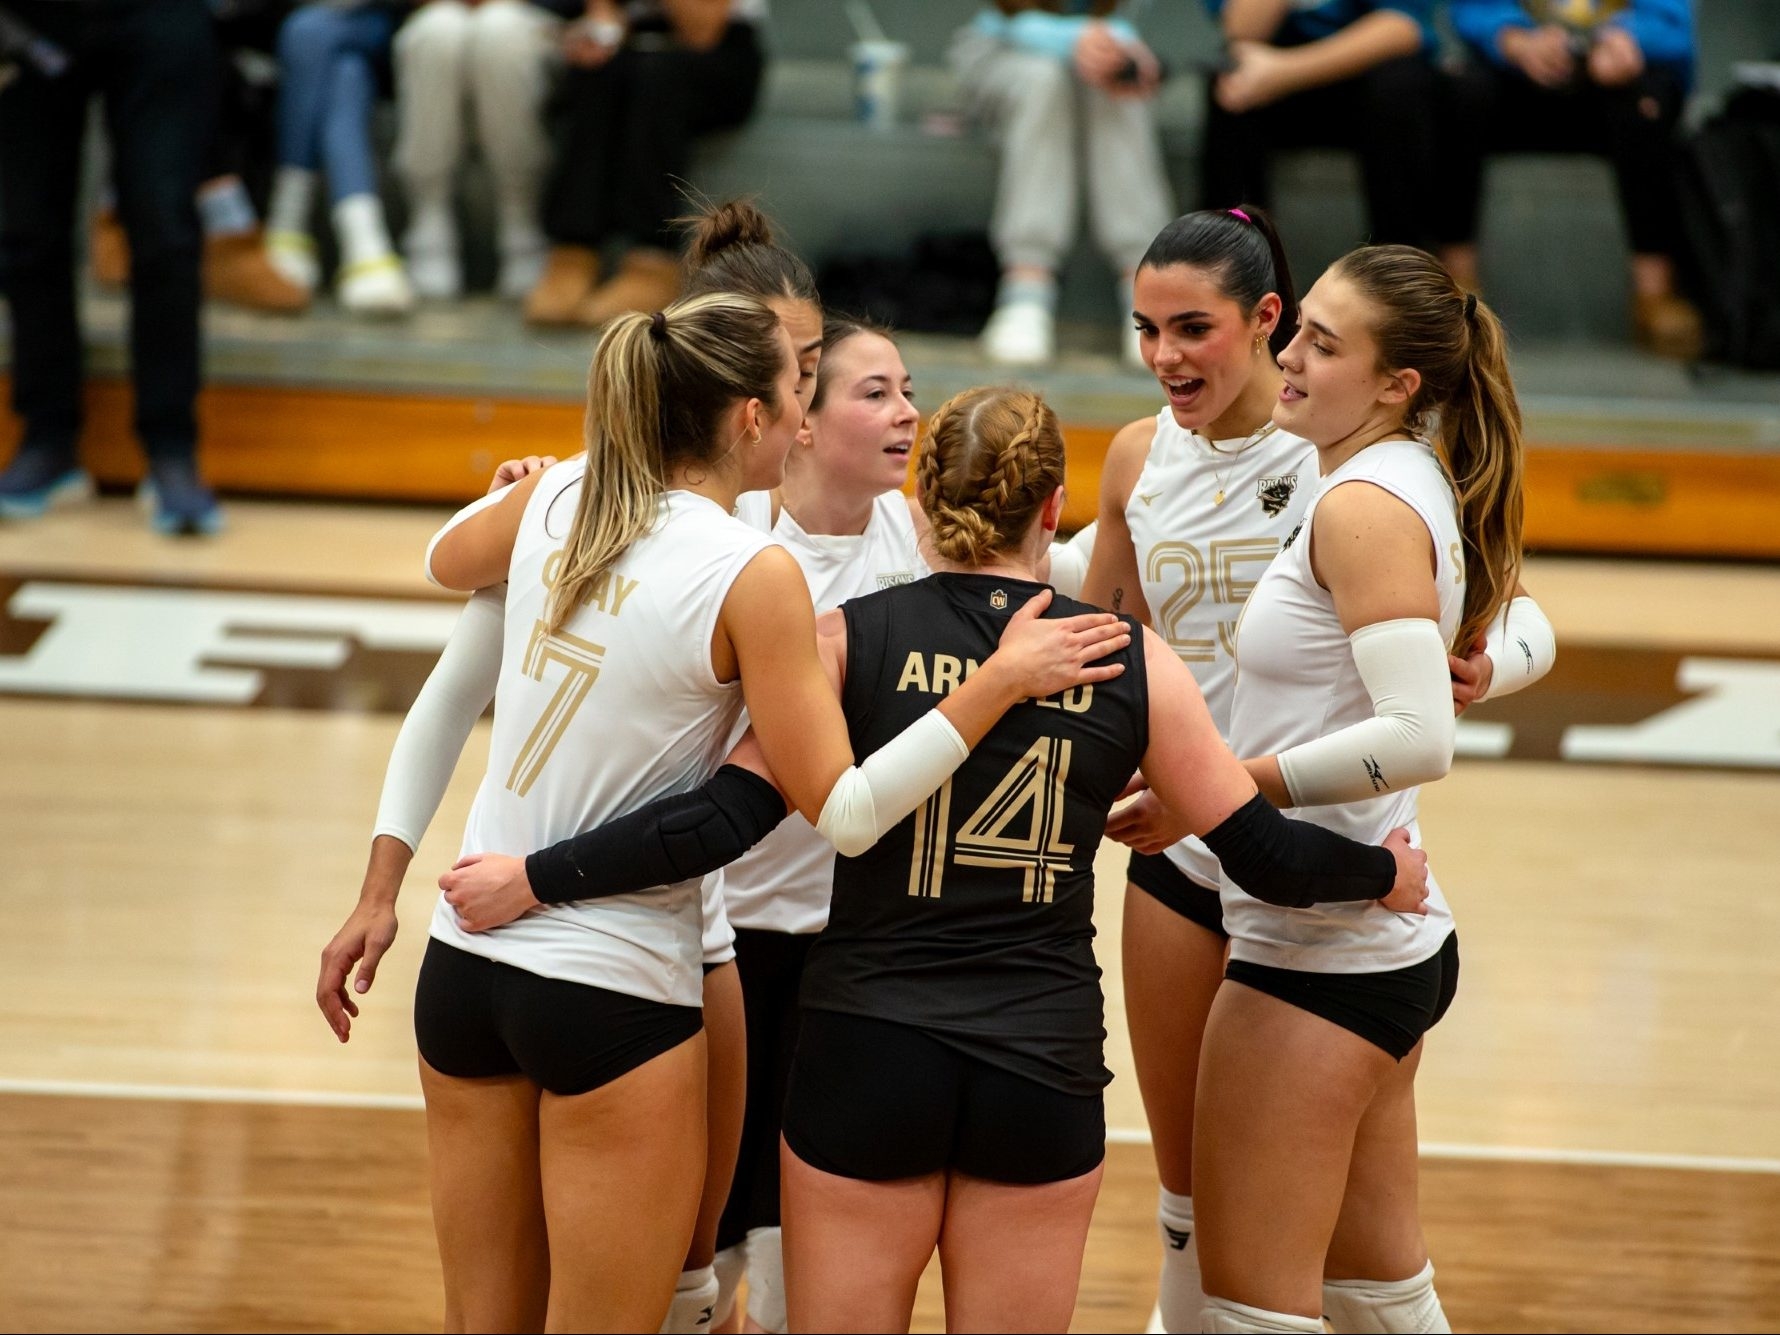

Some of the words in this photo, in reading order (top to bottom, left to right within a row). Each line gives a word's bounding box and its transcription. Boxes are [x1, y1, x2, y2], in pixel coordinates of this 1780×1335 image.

[1257, 474, 1298, 498] BISONS
[541, 549, 641, 617] AY
[1450, 542, 1463, 585] S
[1146, 537, 1280, 662] 25
[505, 618, 607, 798] 7
[896, 651, 1094, 714] ARD
[908, 736, 1076, 903] 14
